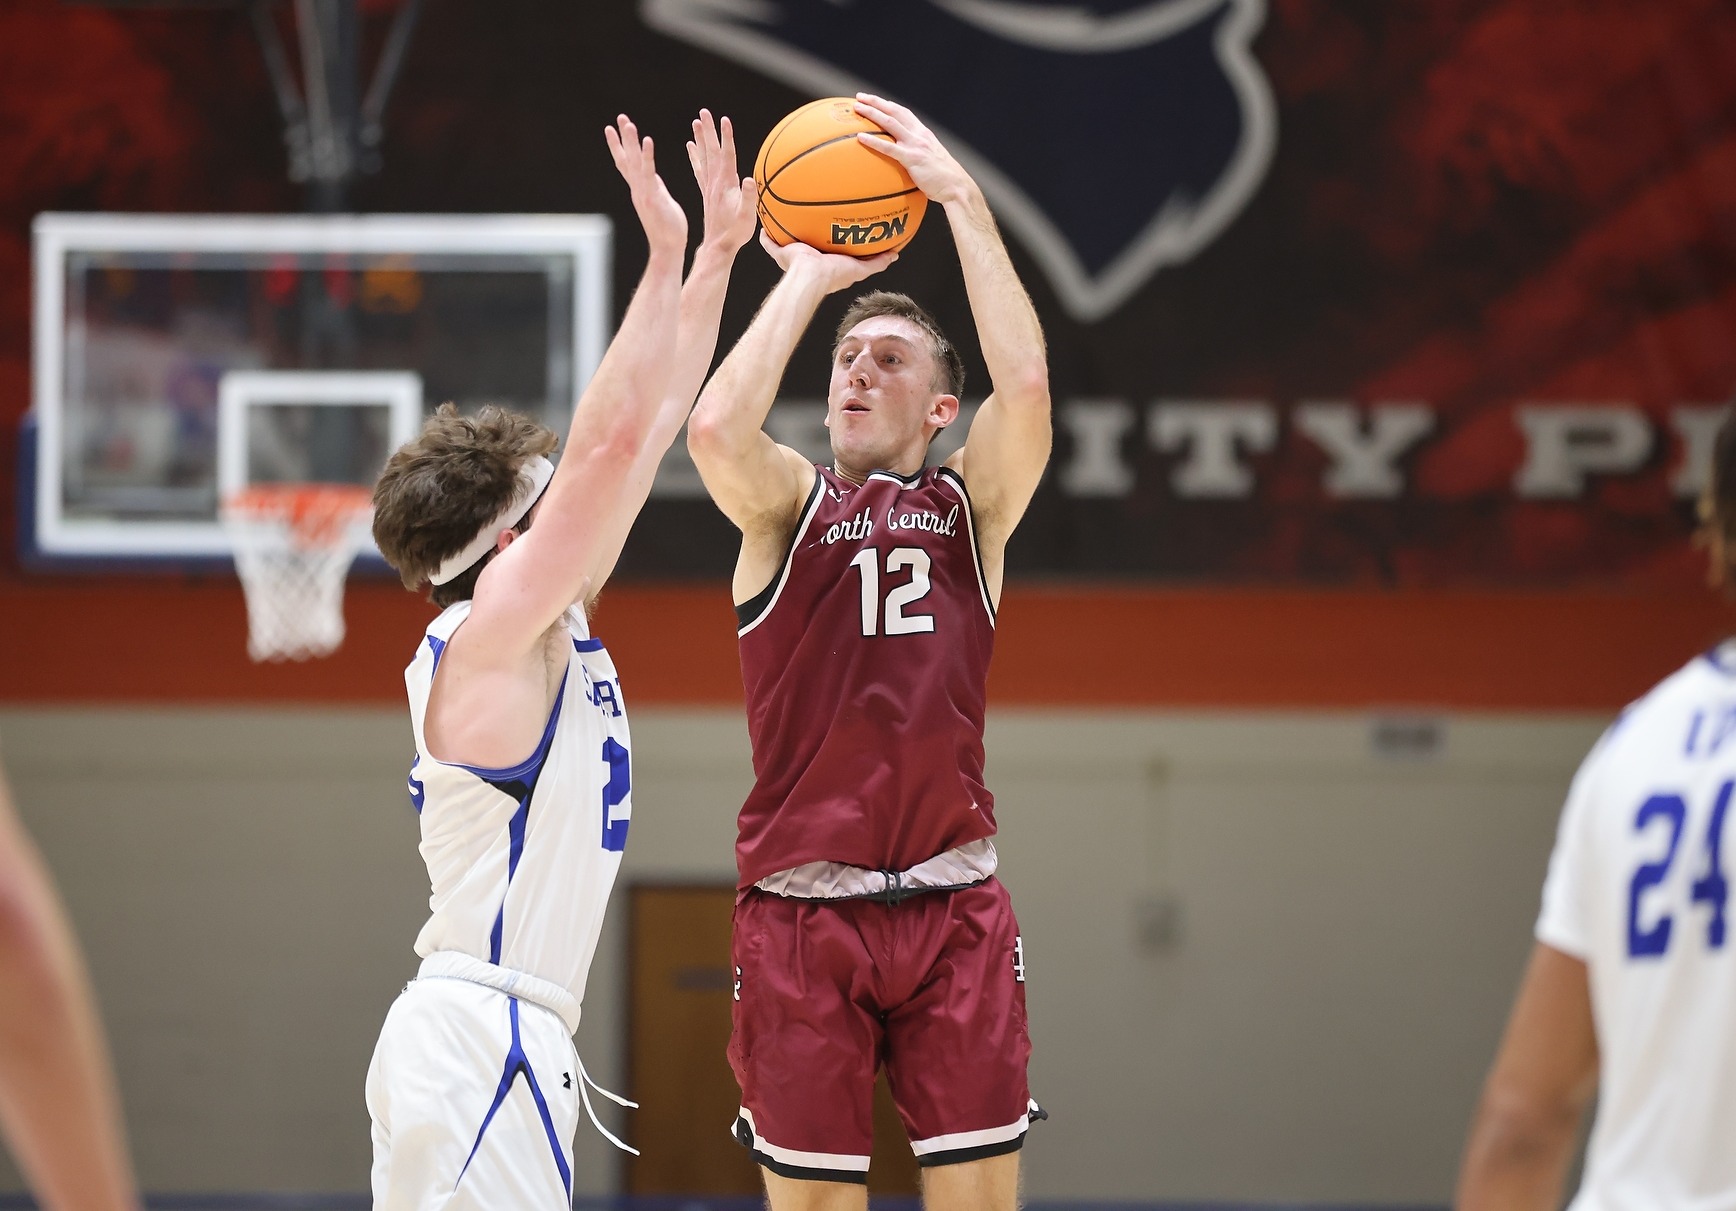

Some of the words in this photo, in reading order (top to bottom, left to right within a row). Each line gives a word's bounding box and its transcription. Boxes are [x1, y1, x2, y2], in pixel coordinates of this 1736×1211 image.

[831, 213, 908, 245] NCAA
[809, 506, 875, 548] orth
[849, 547, 935, 637] 12
